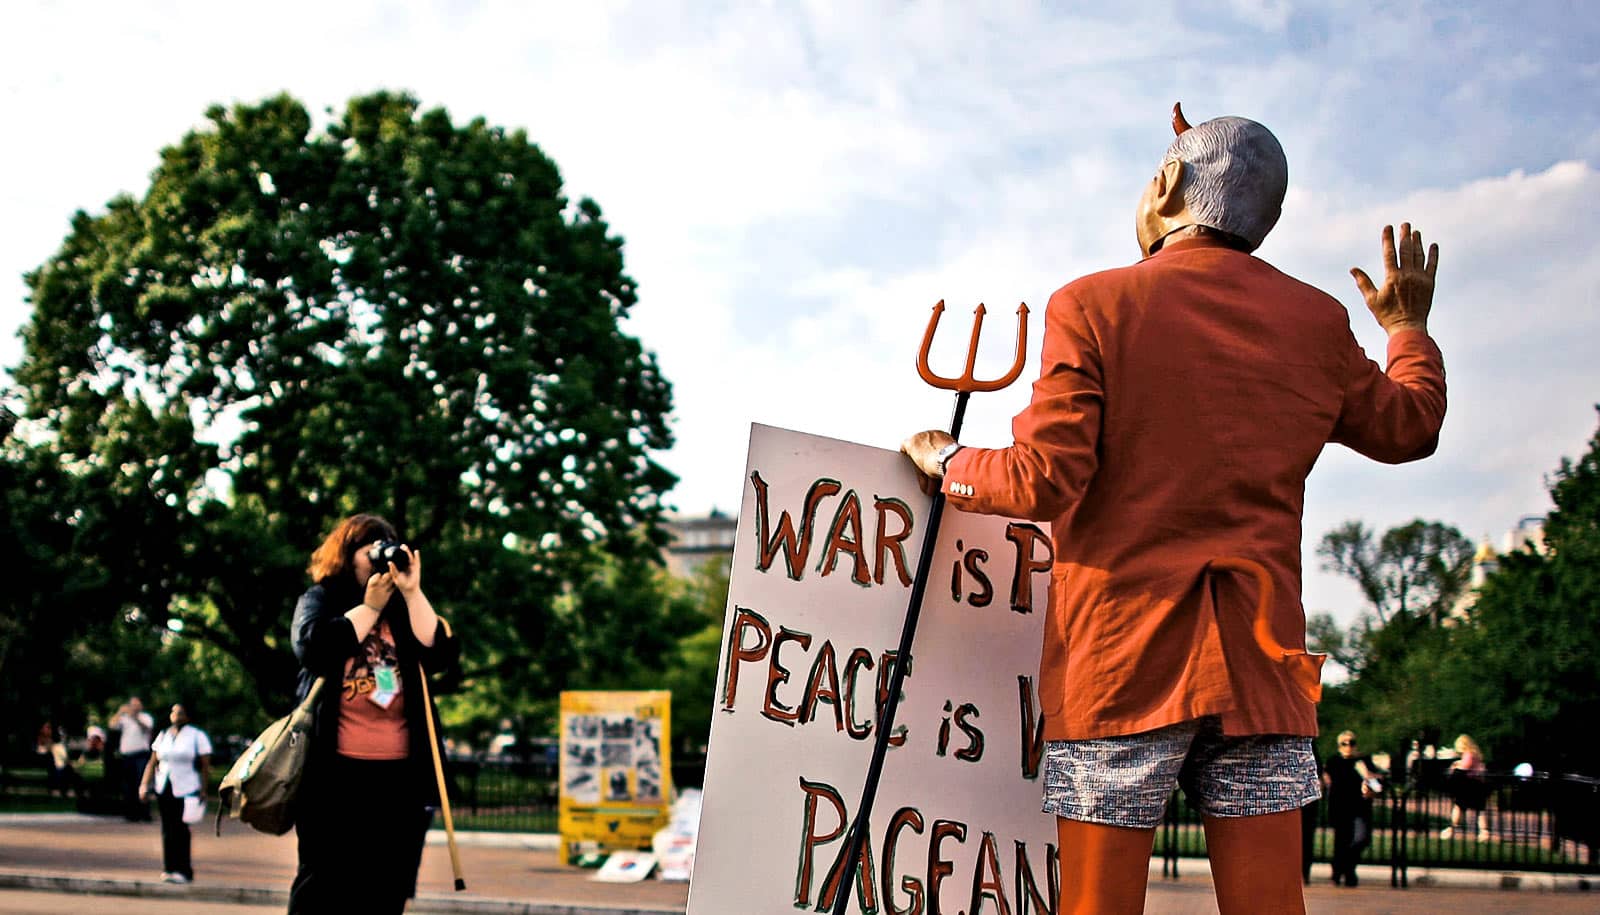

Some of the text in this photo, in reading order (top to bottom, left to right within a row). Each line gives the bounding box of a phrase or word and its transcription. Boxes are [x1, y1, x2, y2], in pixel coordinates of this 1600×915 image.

[751, 470, 1054, 613] WAR is P
[721, 605, 913, 749] PEACE
[936, 700, 985, 762] is
[794, 776, 1060, 915] PAGEAN
